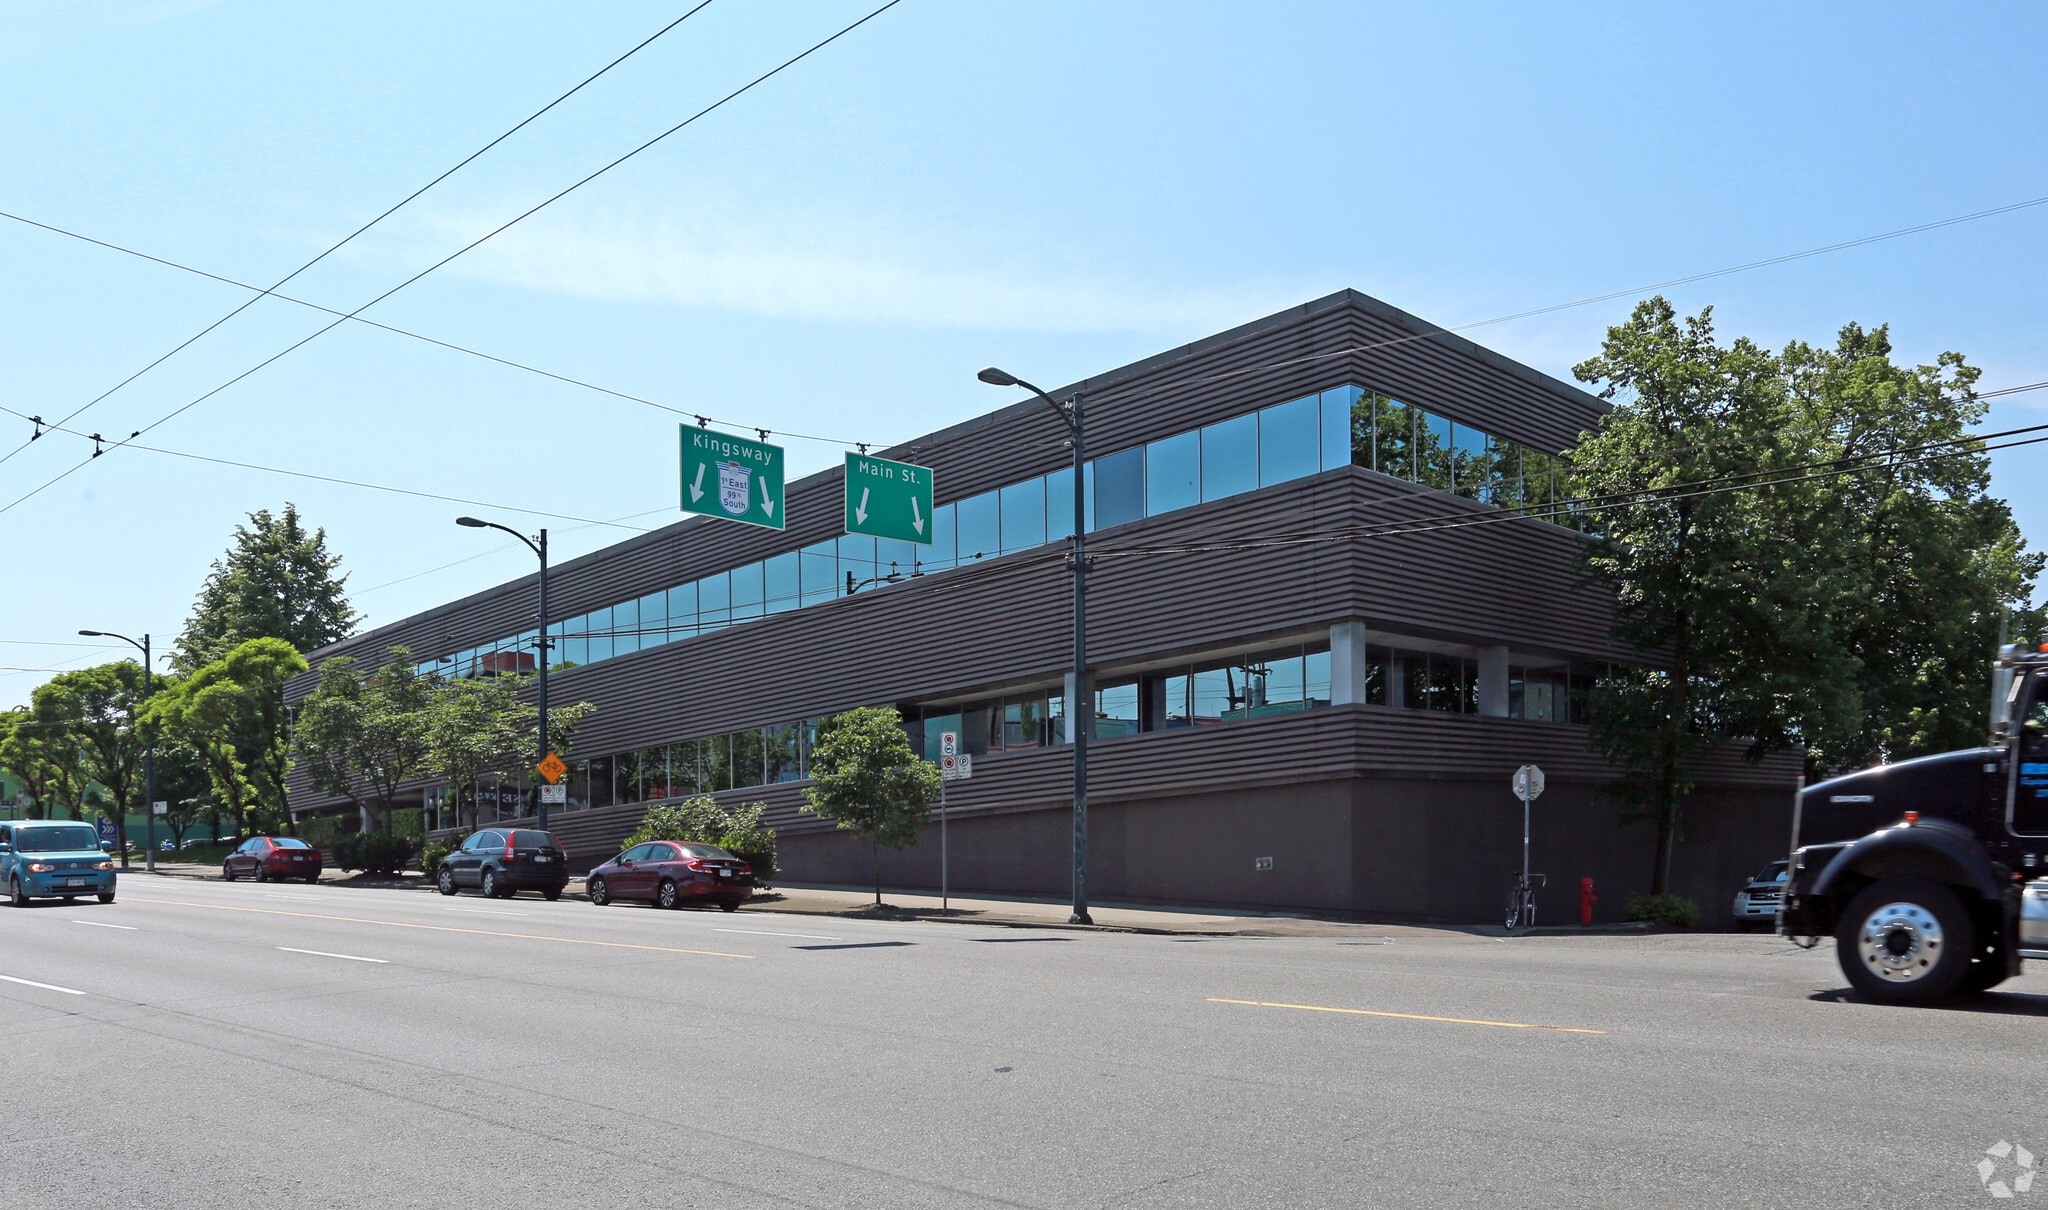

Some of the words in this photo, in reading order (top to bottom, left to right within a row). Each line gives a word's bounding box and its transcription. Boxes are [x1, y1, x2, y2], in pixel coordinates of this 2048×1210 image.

[693, 433, 772, 466] Kingsway
[859, 460, 893, 479] Main
[902, 469, 920, 484] St.
[729, 478, 748, 489] East
[723, 498, 746, 509] South
